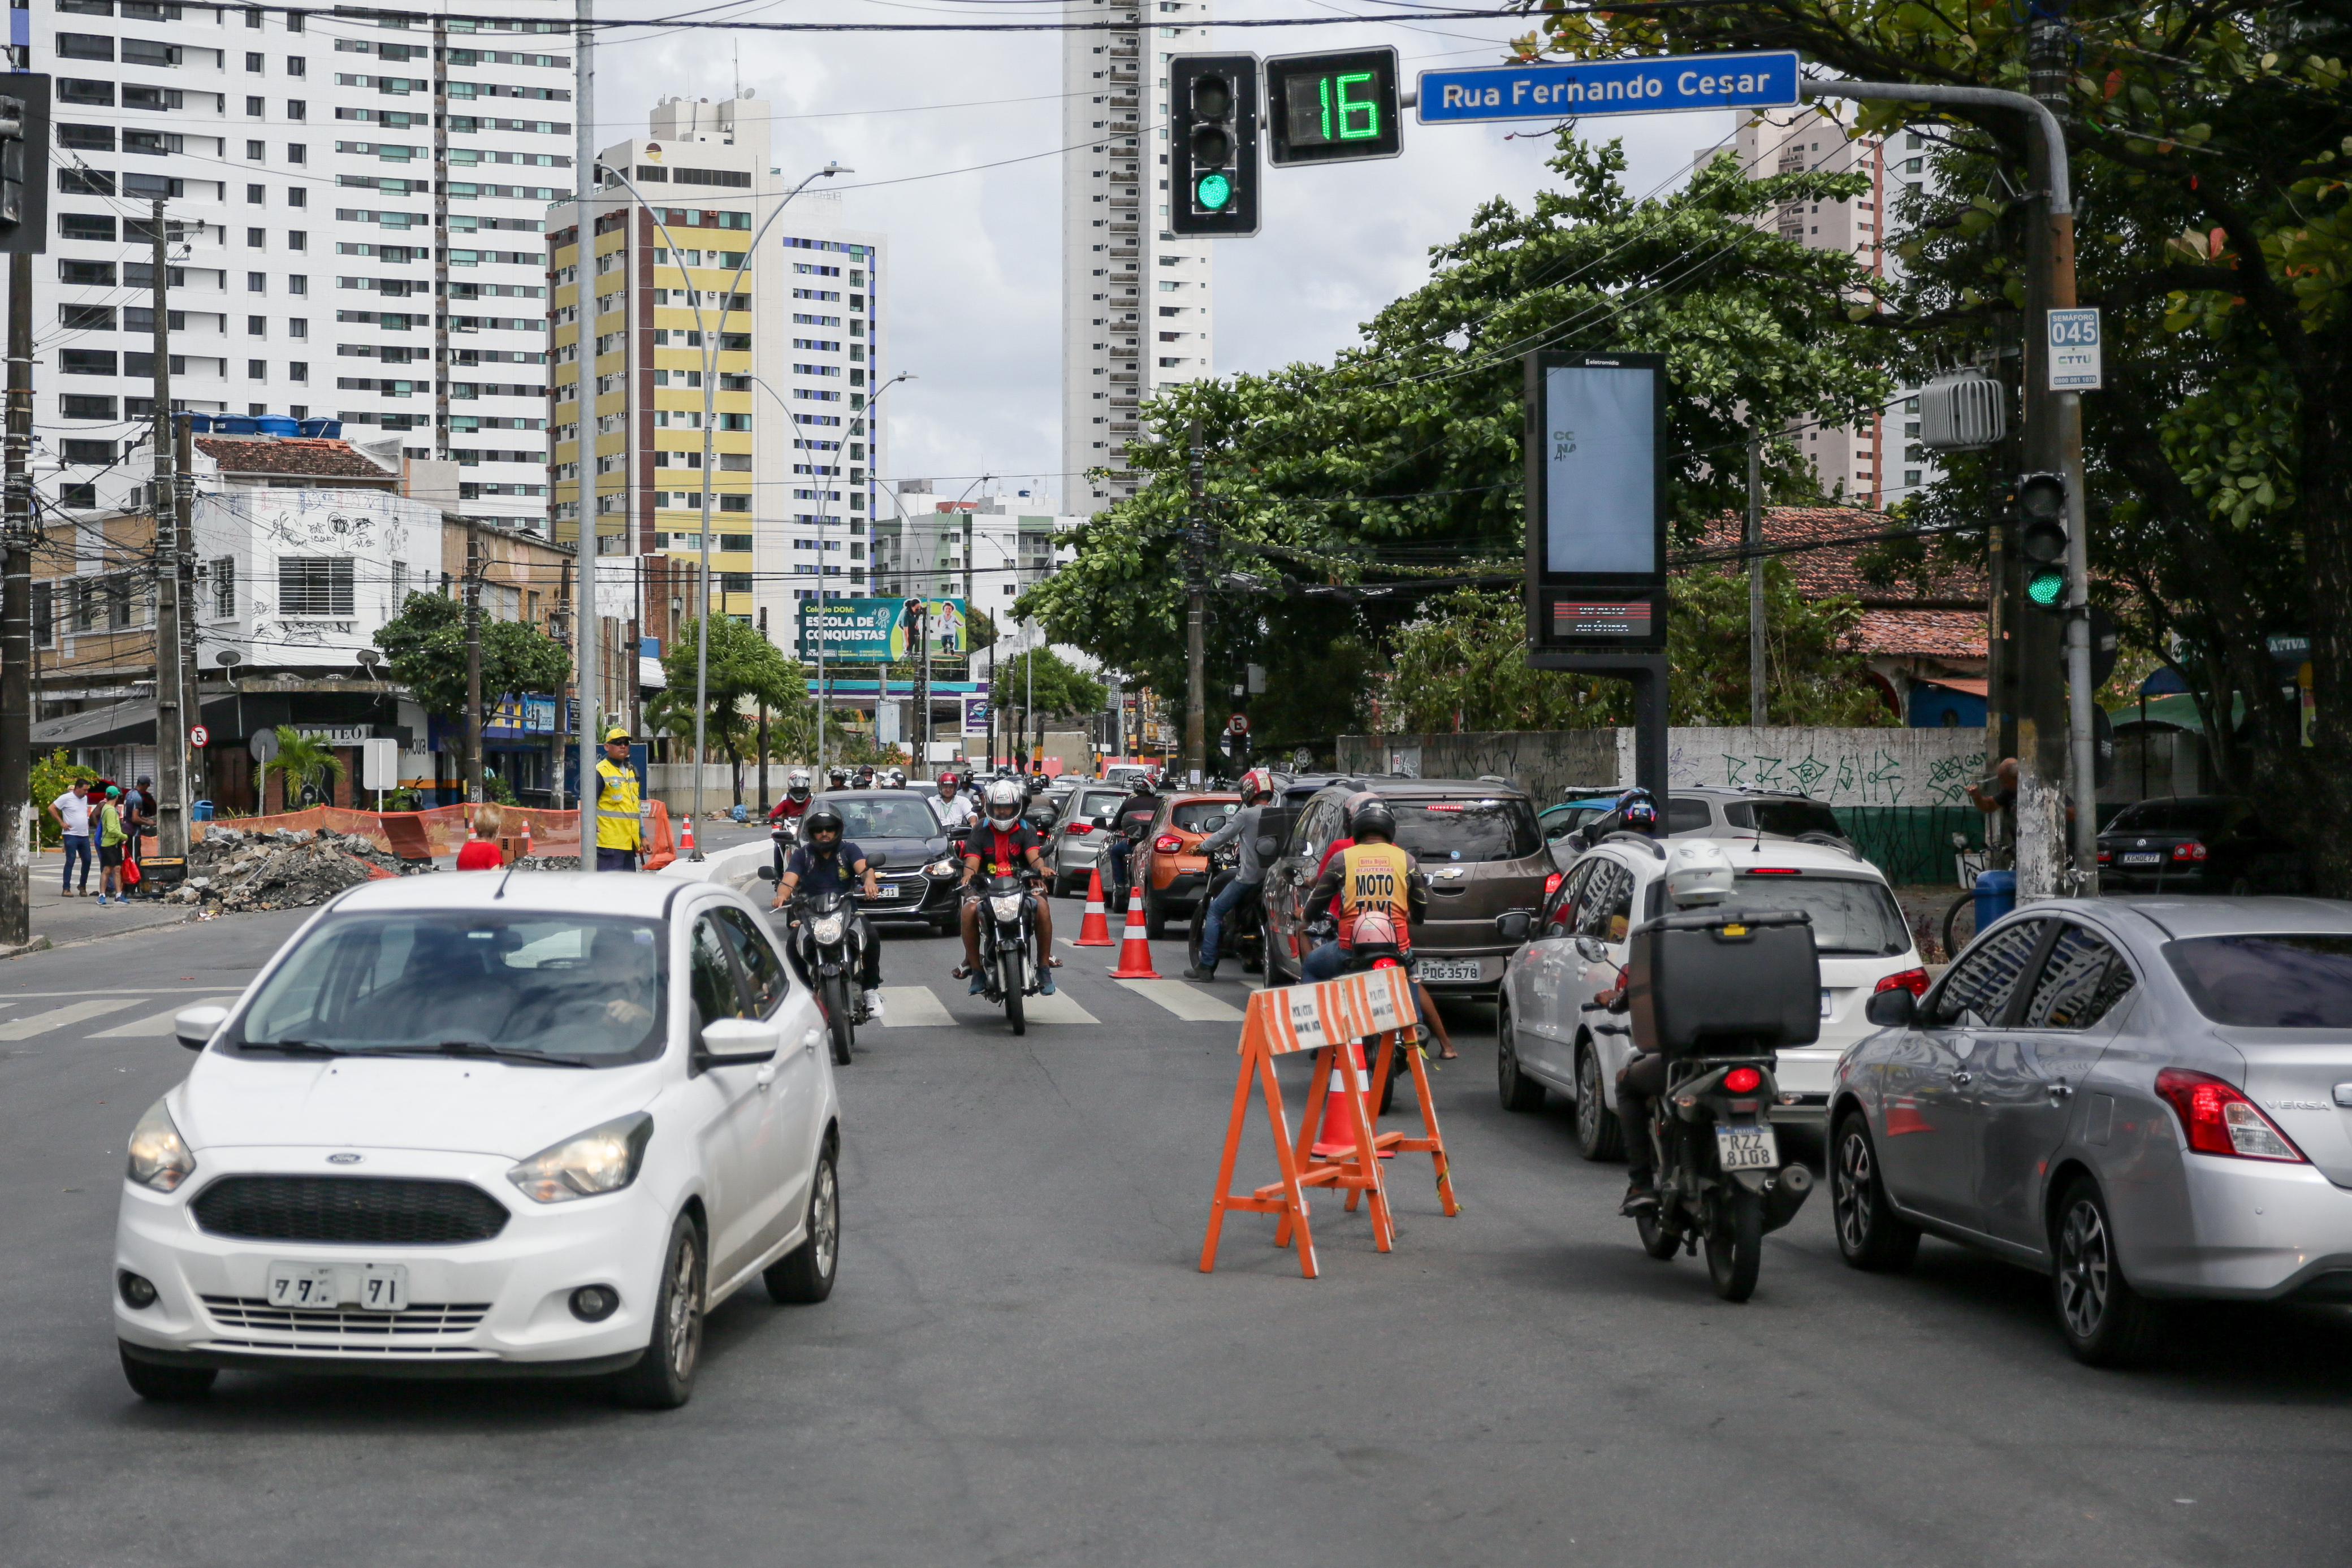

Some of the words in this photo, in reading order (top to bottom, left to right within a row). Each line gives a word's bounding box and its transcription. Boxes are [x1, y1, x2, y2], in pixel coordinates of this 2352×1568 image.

[1443, 84, 1501, 109] Rua
[1512, 73, 1663, 106] Fernando
[1677, 71, 1771, 96] Cesar
[1319, 72, 1378, 140] 16
[2052, 322, 2096, 343] 045
[2058, 354, 2092, 365] CTTU
[857, 616, 874, 627] DE
[1355, 874, 1394, 896] MOTO
[2265, 1100, 2331, 1111] VERSA
[1730, 1134, 1763, 1150] RZZ
